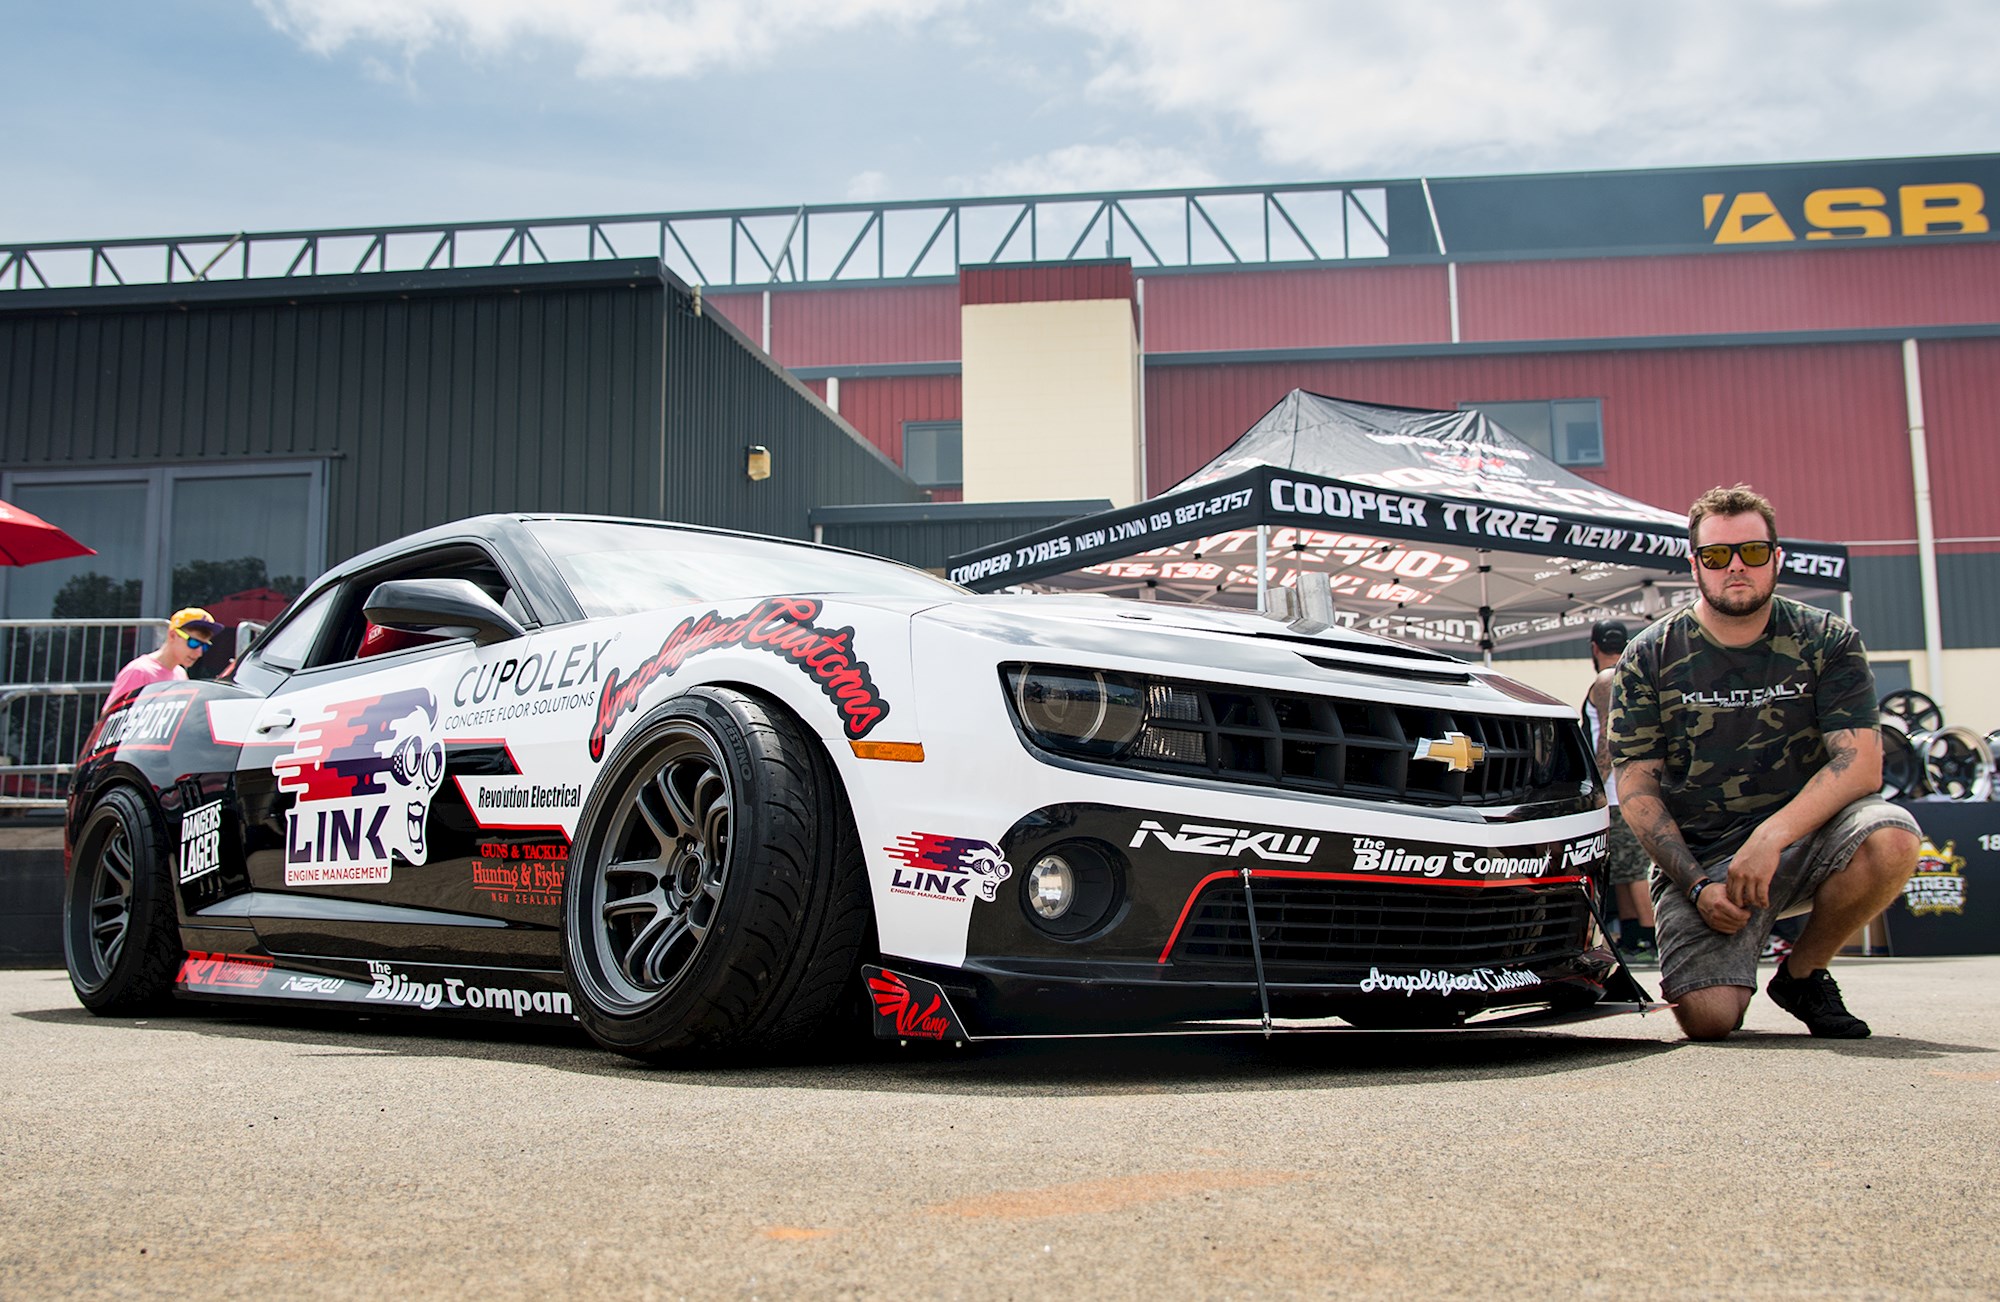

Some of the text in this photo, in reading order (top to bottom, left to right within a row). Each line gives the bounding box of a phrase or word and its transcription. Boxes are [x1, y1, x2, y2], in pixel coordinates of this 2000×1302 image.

[1703, 182, 1990, 244] ASB
[1270, 478, 1428, 527] COOPER
[1441, 502, 1559, 543] TYRES
[1564, 524, 1629, 551] NEW
[950, 553, 1012, 585] COOPER
[1016, 535, 1071, 567] TYRES
[1075, 529, 1106, 552] NEW
[1109, 517, 1147, 543] LYNN
[1151, 511, 1172, 532] 09
[1175, 489, 1253, 525] 827-2757
[454, 638, 612, 708] CUPOLEX
[747, 598, 886, 736] Customs
[445, 691, 595, 730] CONCRETE FLOOR SOLUTIONS
[715, 714, 753, 781] ZESTINO
[531, 783, 581, 808] Electrical
[181, 804, 222, 843] DANGERS
[289, 805, 391, 863] LINK
[180, 829, 220, 878] LAGER
[481, 843, 568, 861] GUNS & TACKLE
[1352, 838, 1385, 850] The
[1352, 848, 1548, 879] Bling Company
[288, 866, 388, 881] ENGINE MANAGEMENT
[533, 861, 565, 894] Fishi
[892, 869, 971, 897] LINK
[890, 887, 967, 903] ENGINE MANAGEMENT
[367, 961, 391, 975] The
[1360, 966, 1488, 997] Amplified
[366, 974, 580, 1021] Bling Compan
[880, 984, 950, 1040] Wang
